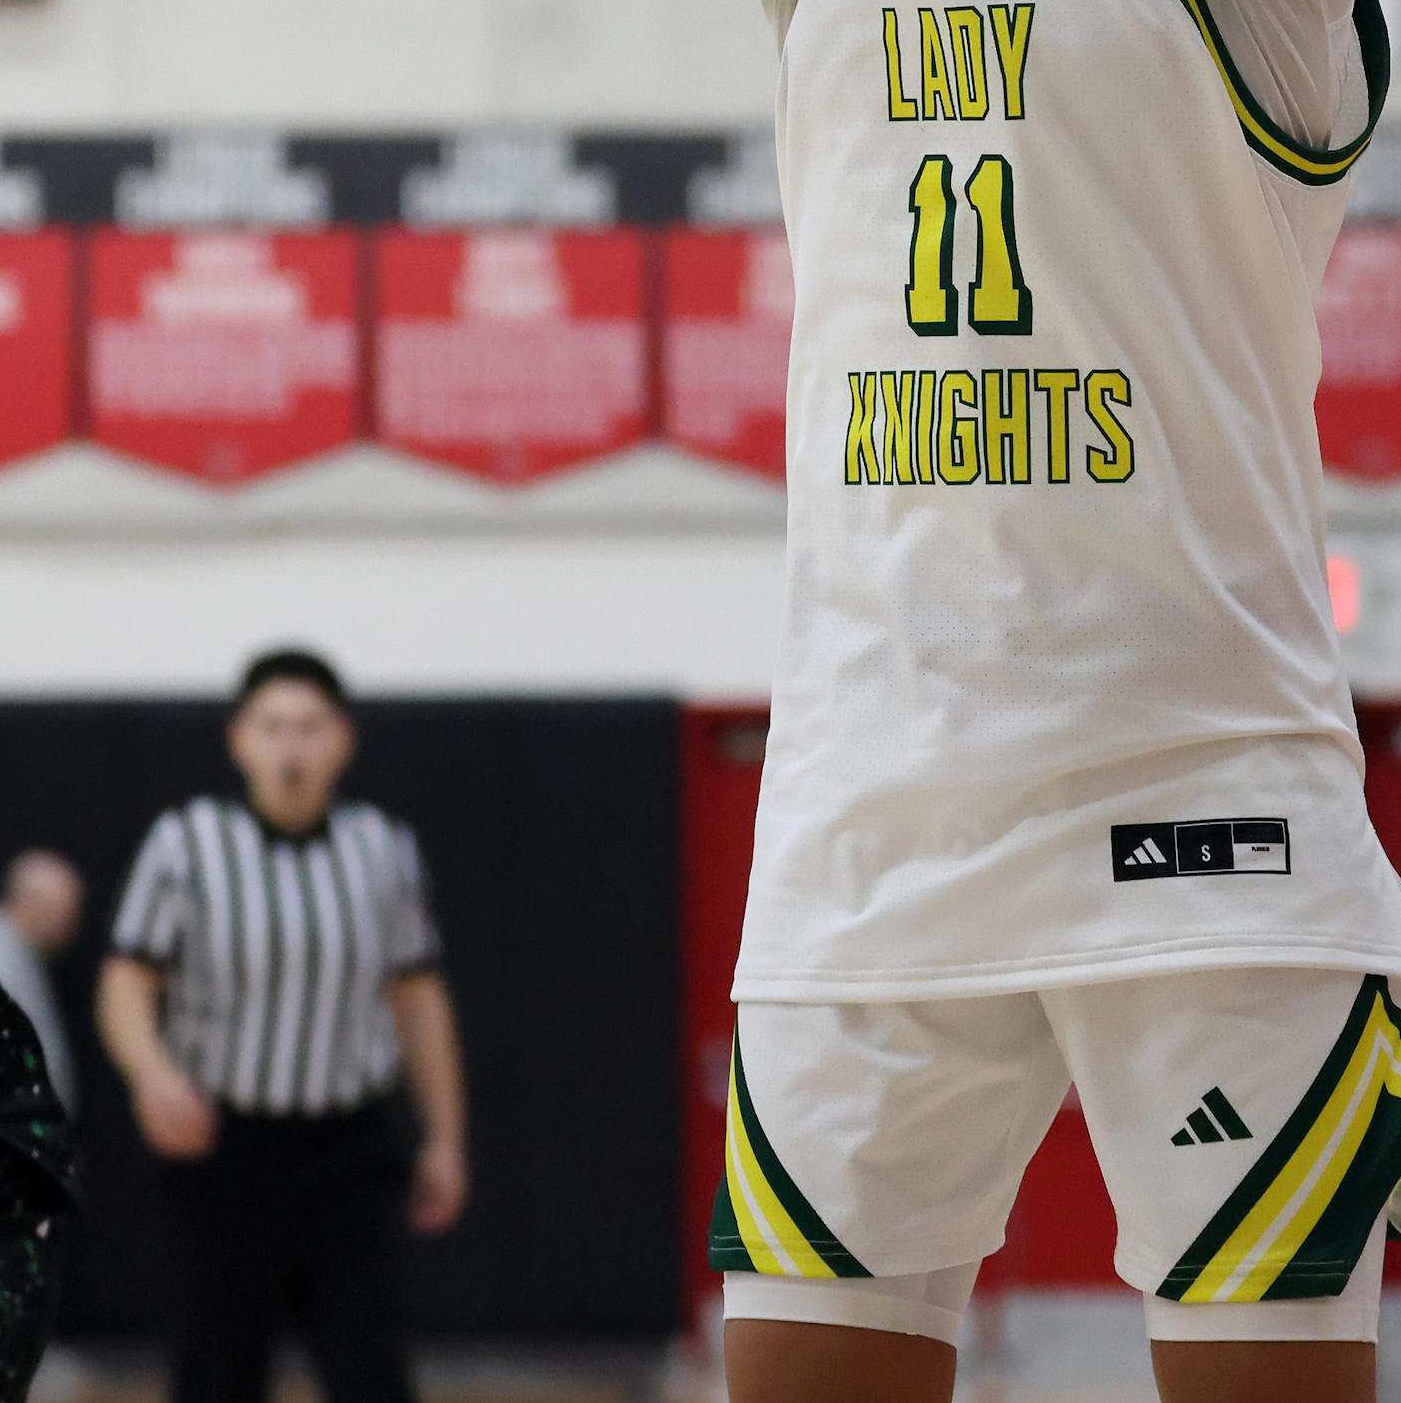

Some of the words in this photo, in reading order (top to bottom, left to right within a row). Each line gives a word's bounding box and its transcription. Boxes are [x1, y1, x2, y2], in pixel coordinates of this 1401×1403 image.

[882, 2, 1036, 122] LADY
[904, 154, 1033, 336] 11
[844, 368, 1134, 486] KNIGHTS
[1201, 844, 1212, 863] S
